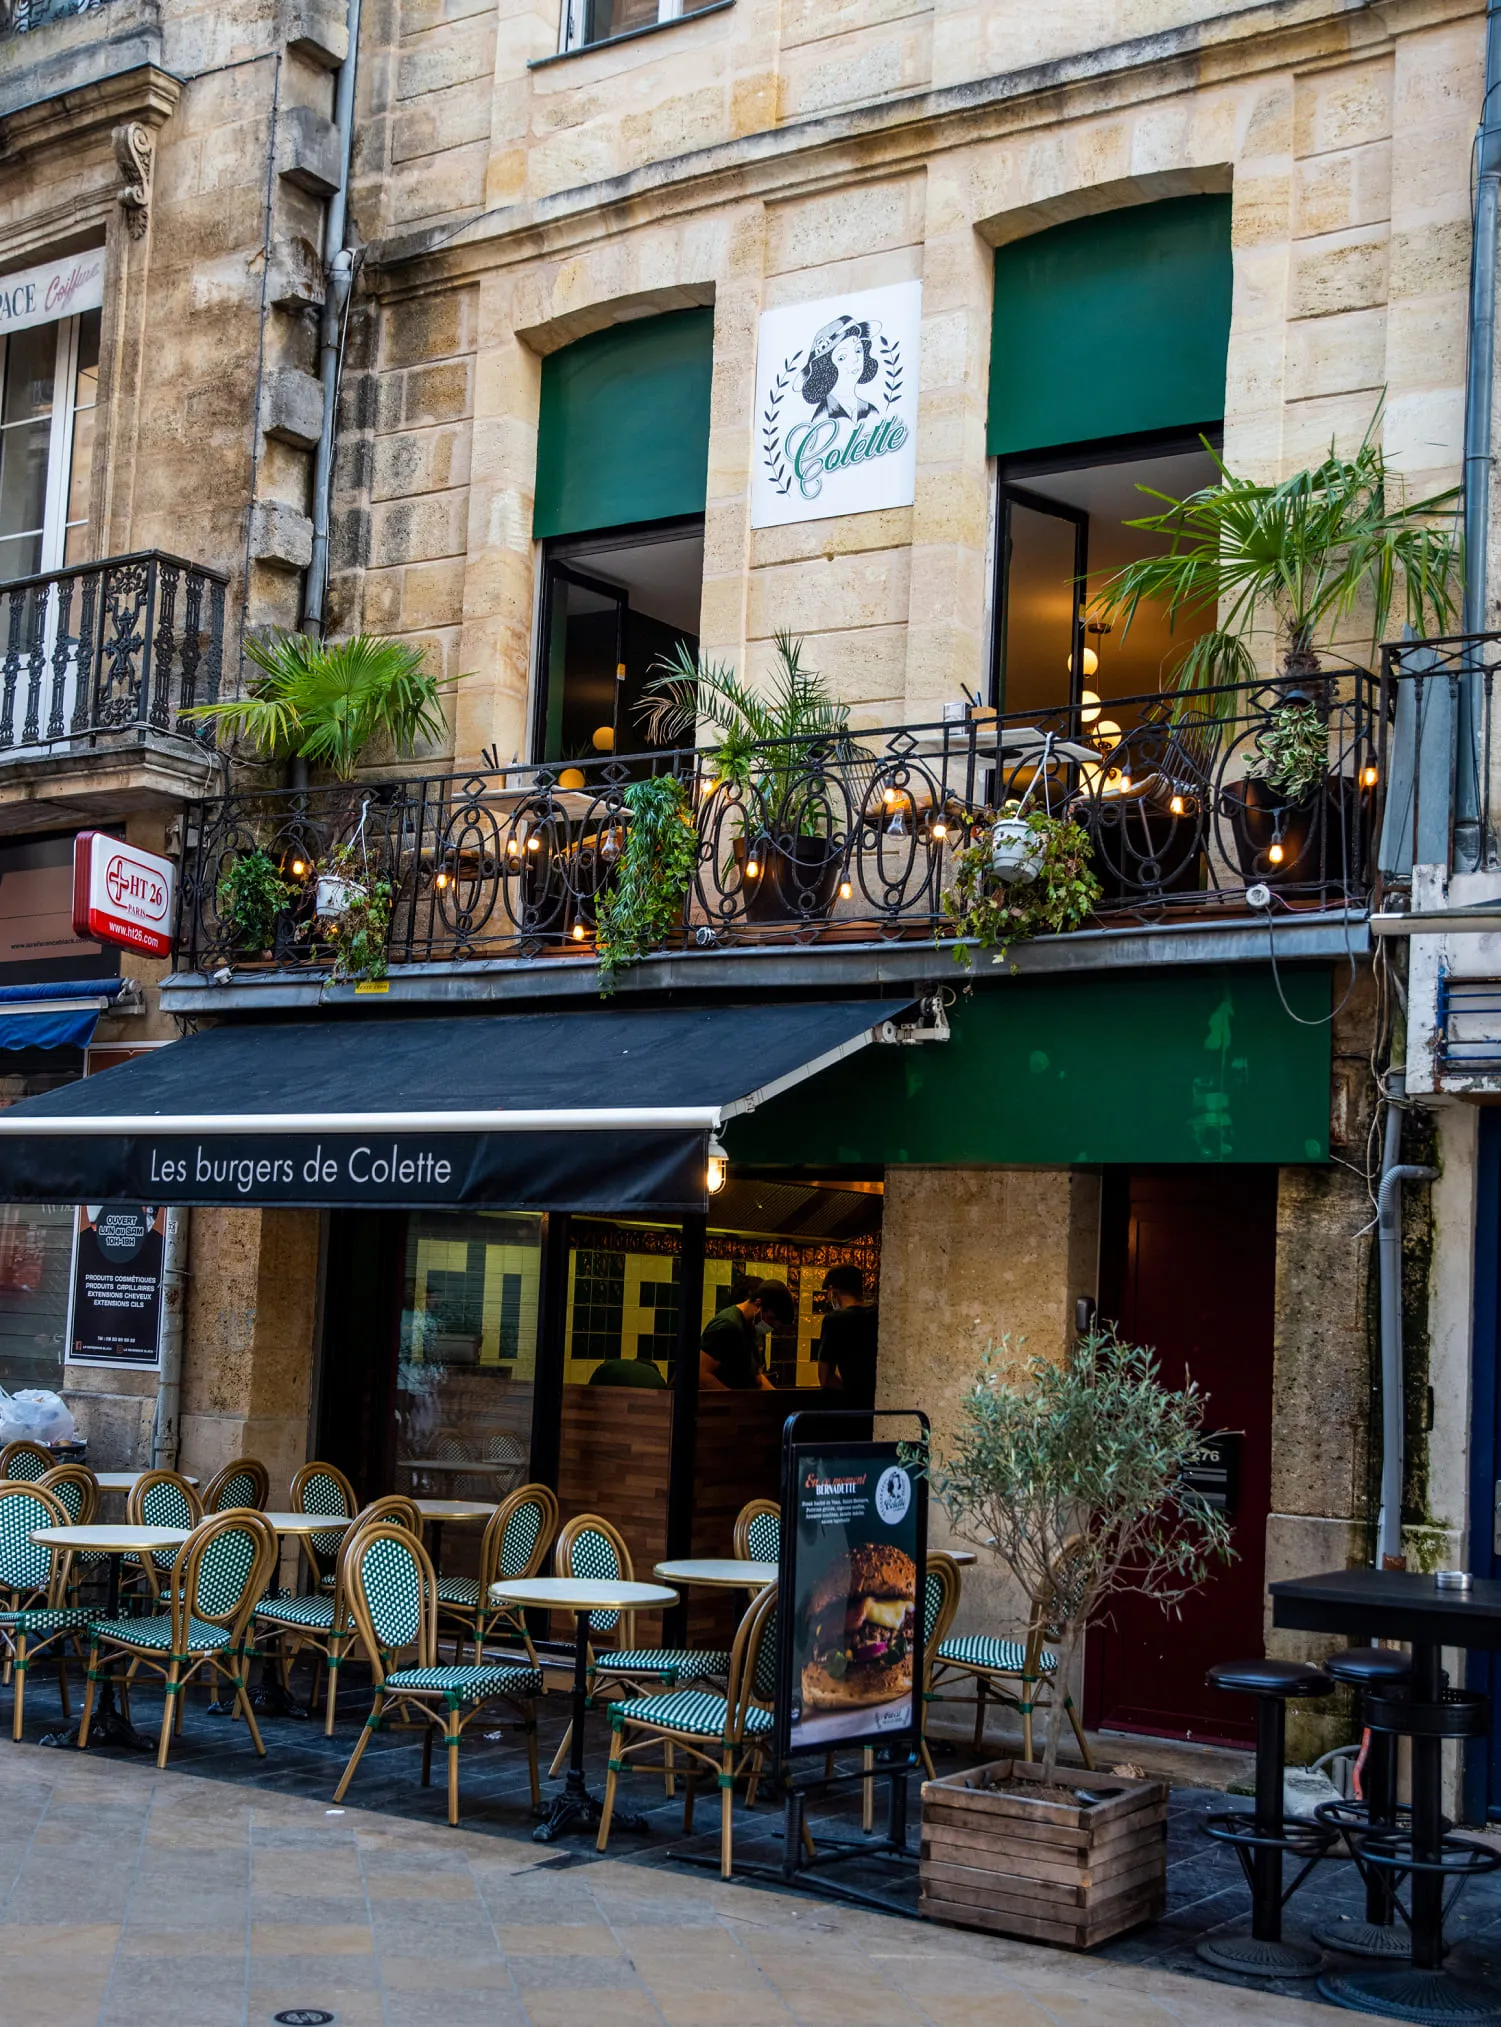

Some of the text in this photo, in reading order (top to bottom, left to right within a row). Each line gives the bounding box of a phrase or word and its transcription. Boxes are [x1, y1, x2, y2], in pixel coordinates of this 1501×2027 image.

[0, 263, 100, 320] ACE Coiffure
[785, 415, 908, 499] Colette
[130, 875, 163, 906] HT 26
[128, 904, 147, 918] PARIS
[109, 922, 159, 948] www.ht26.com
[150, 1144, 451, 1193] Les burgers de Colette
[107, 1215, 138, 1226] OUVERT
[99, 1225, 116, 1236] LUN
[126, 1226, 144, 1237] SAM
[85, 1274, 156, 1284] PRODUITS COSMÉTIQUES
[85, 1282, 155, 1292] PRODUITS CAPILLAIRES
[88, 1291, 152, 1300] EXTENSIONS CHEVEUX
[93, 1299, 144, 1308] EXTENSIONS CILS
[805, 1473, 819, 1488] En
[832, 1473, 867, 1486] moment
[816, 1482, 856, 1495] BERNADETTE
